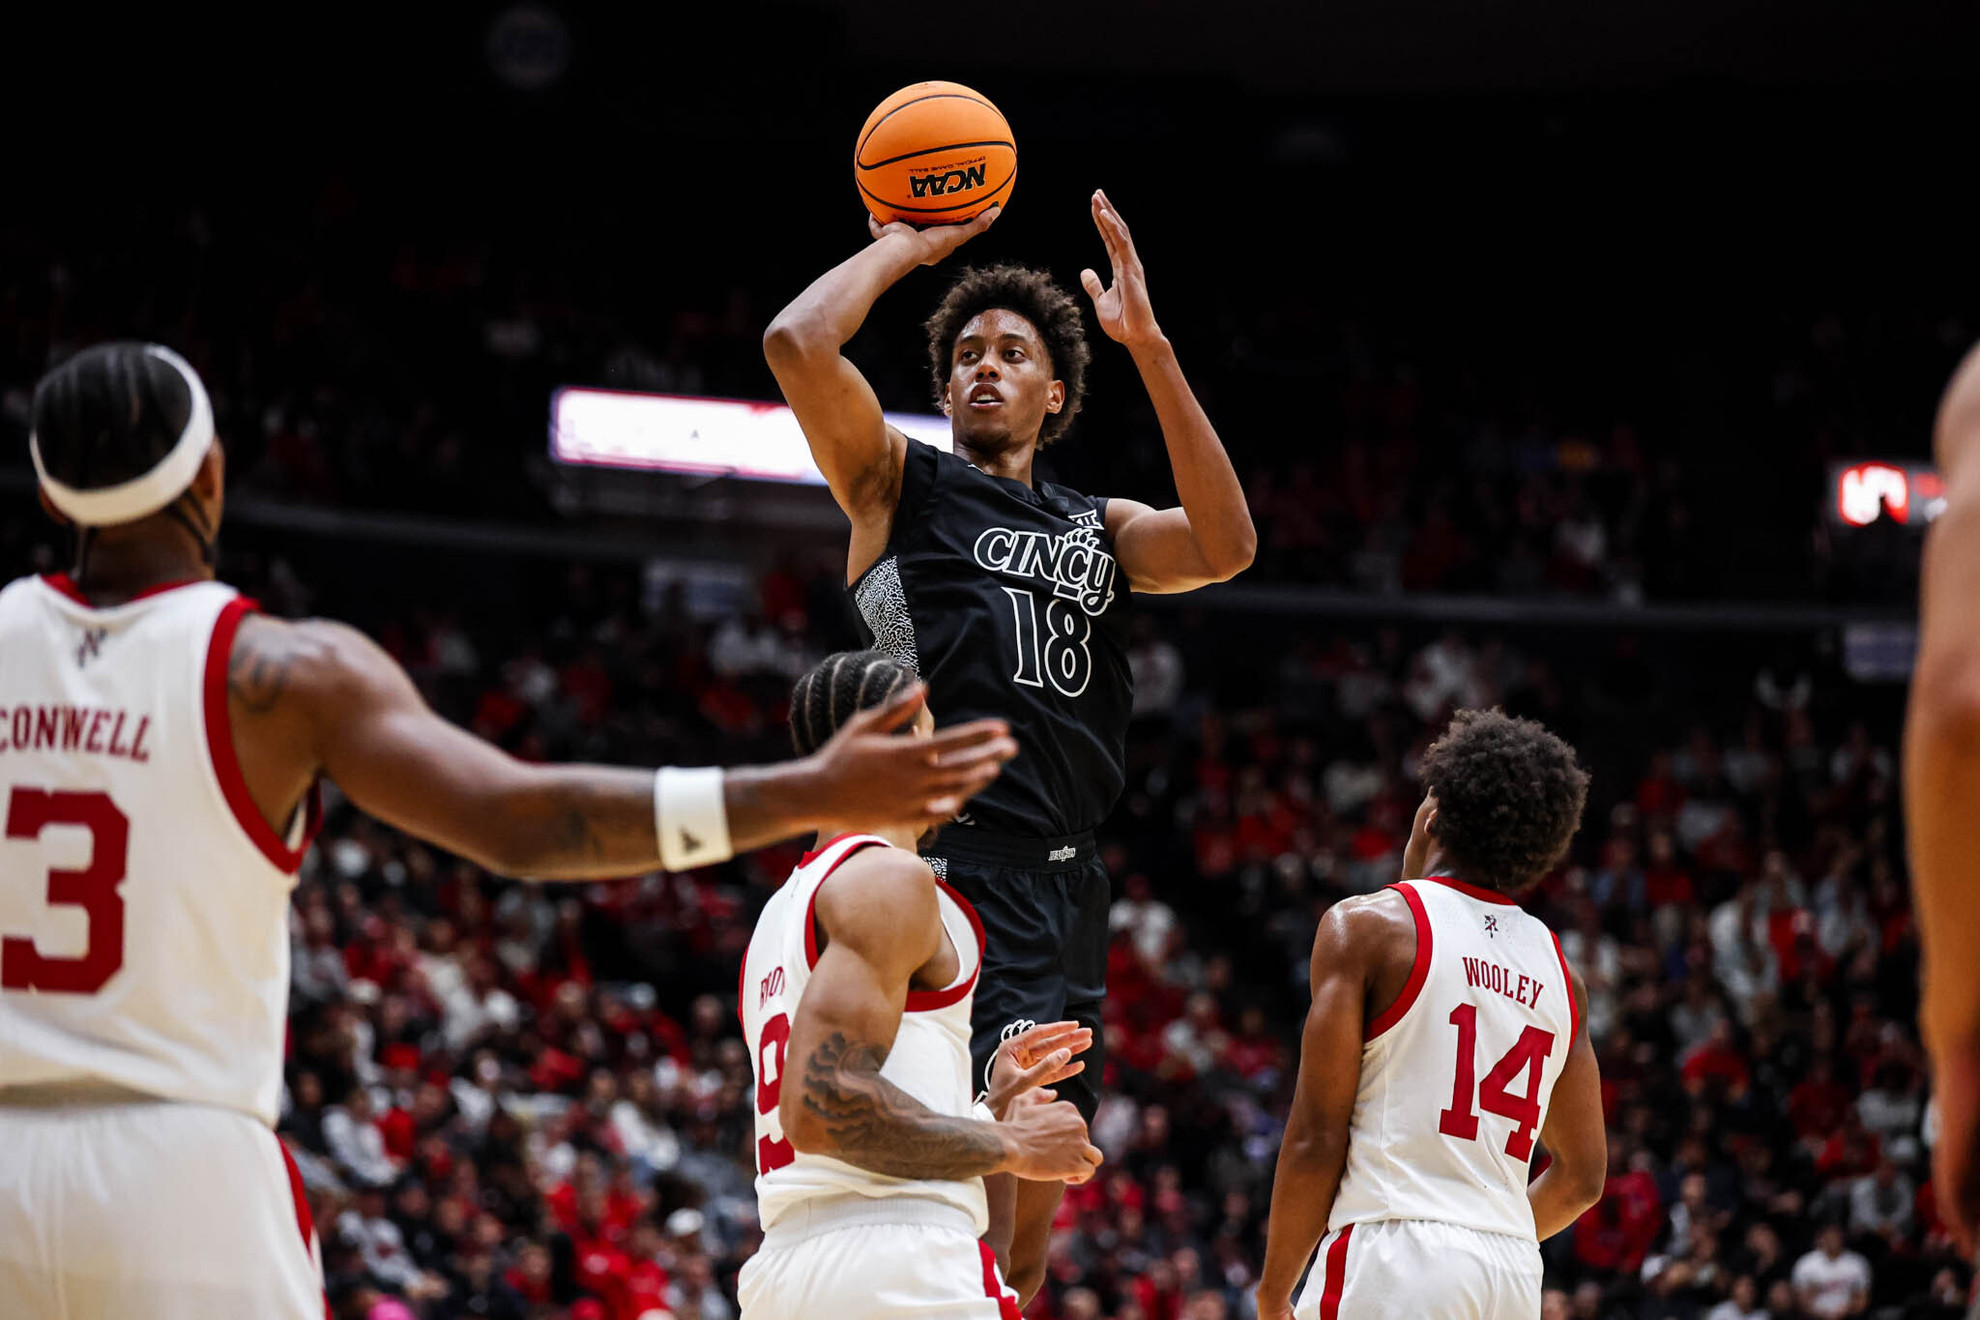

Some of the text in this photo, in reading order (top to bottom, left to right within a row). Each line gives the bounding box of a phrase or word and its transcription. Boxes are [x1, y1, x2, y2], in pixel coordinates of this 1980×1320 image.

[908, 162, 986, 198] NCAA
[973, 527, 1116, 616] CINCY
[1001, 587, 1092, 697] 18
[1, 786, 129, 994] 3
[1462, 957, 1544, 1010] WOOLEY
[757, 1012, 795, 1177] 9
[1439, 1002, 1556, 1163] 14
